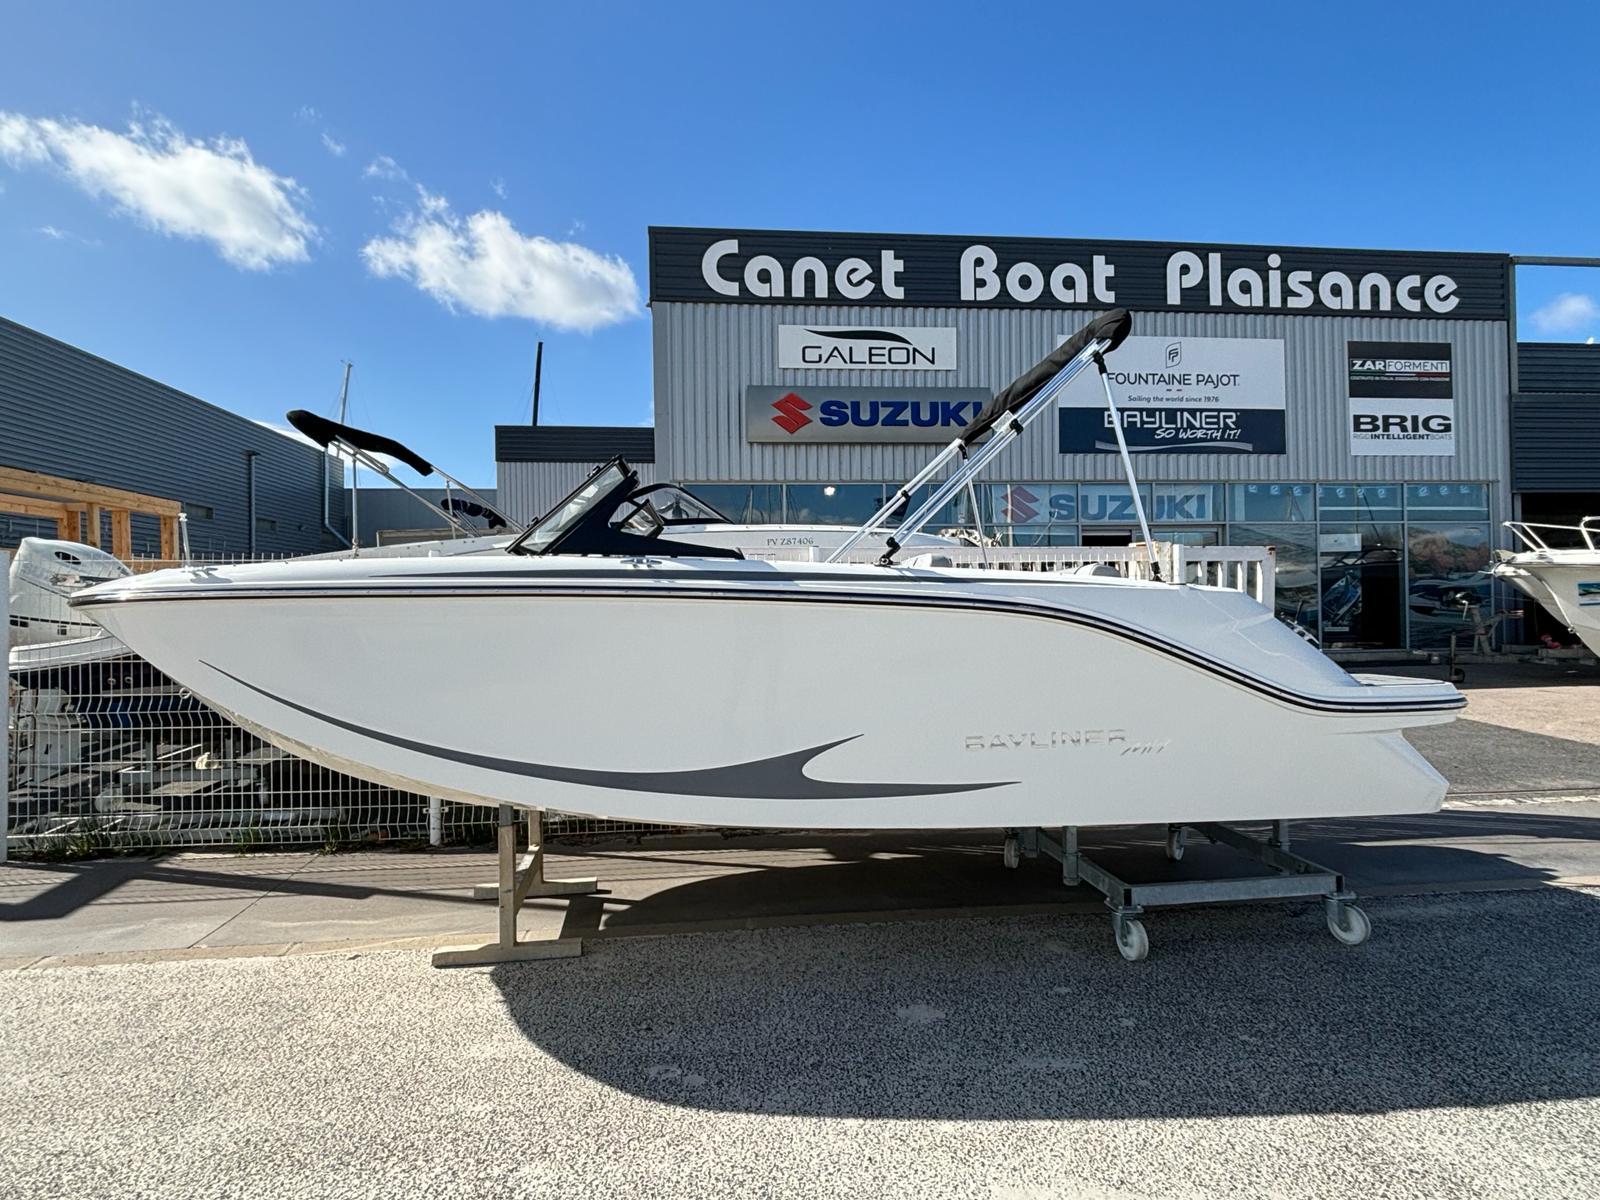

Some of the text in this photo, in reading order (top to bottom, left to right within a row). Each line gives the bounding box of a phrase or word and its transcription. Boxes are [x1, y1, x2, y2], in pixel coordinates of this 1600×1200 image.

[702, 239, 1460, 313] Canet Boat Plaisance
[801, 345, 936, 364] GALEON
[1107, 372, 1239, 388] FOUNTAINE PAJOT
[1128, 395, 1151, 403] Sailing
[1353, 414, 1452, 433] BRIG
[1154, 428, 1242, 440] SO WORTH IT!
